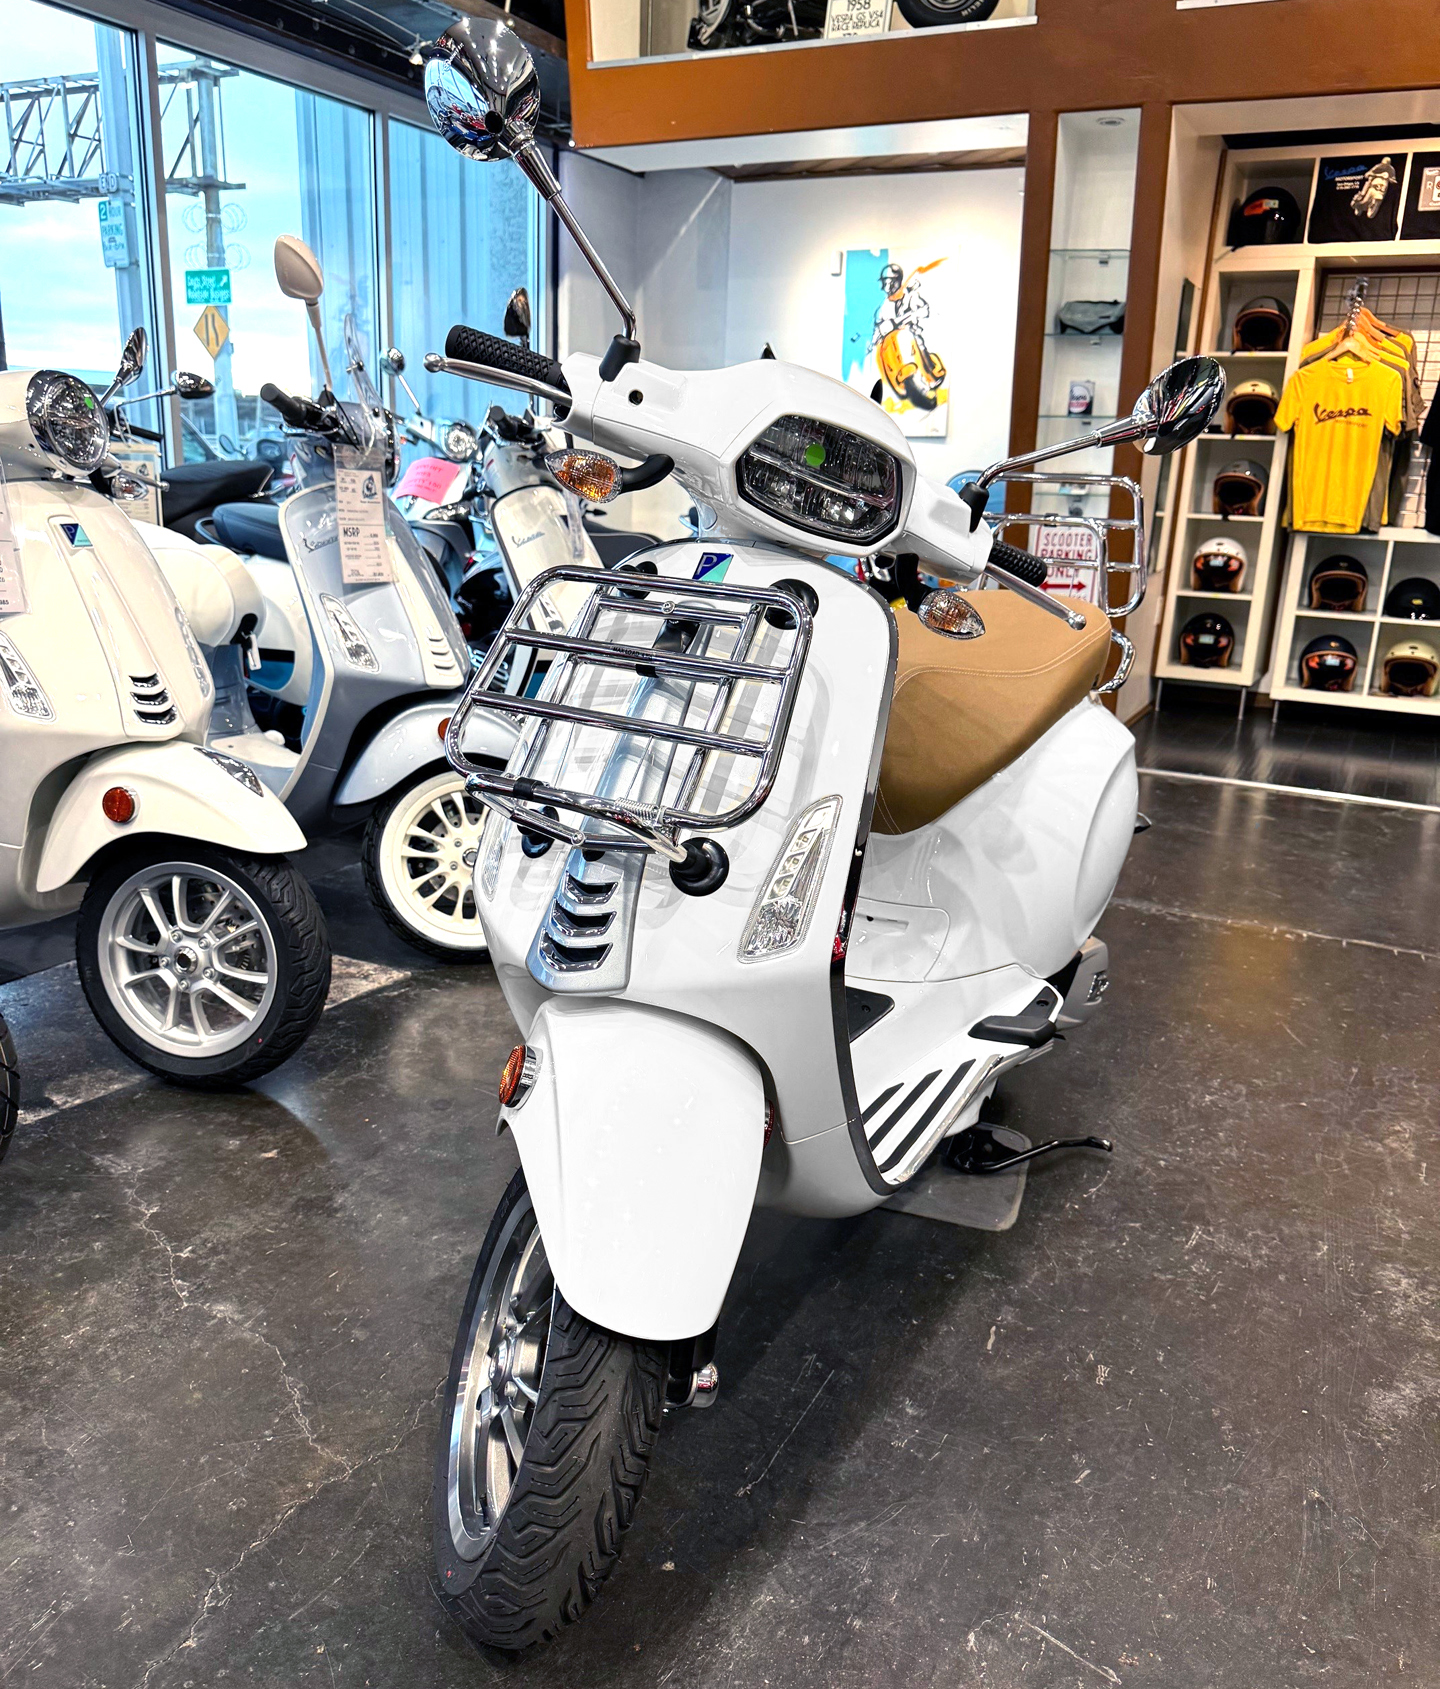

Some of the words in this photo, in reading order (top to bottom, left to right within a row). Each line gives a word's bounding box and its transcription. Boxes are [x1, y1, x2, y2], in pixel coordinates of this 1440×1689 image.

[847, 0, 871, 11] 1958
[831, 14, 853, 23] VESPA
[831, 21, 850, 31] RACE
[852, 18, 880, 29] REPLICA
[1324, 164, 1368, 180] Vespa
[102, 223, 124, 237] PARKING
[1313, 402, 1372, 425] Vespa
[342, 527, 360, 538] MSRP
[1043, 531, 1093, 548] SCOOTER
[1041, 549, 1093, 561] PARKING
[1047, 566, 1080, 578] ONLY
